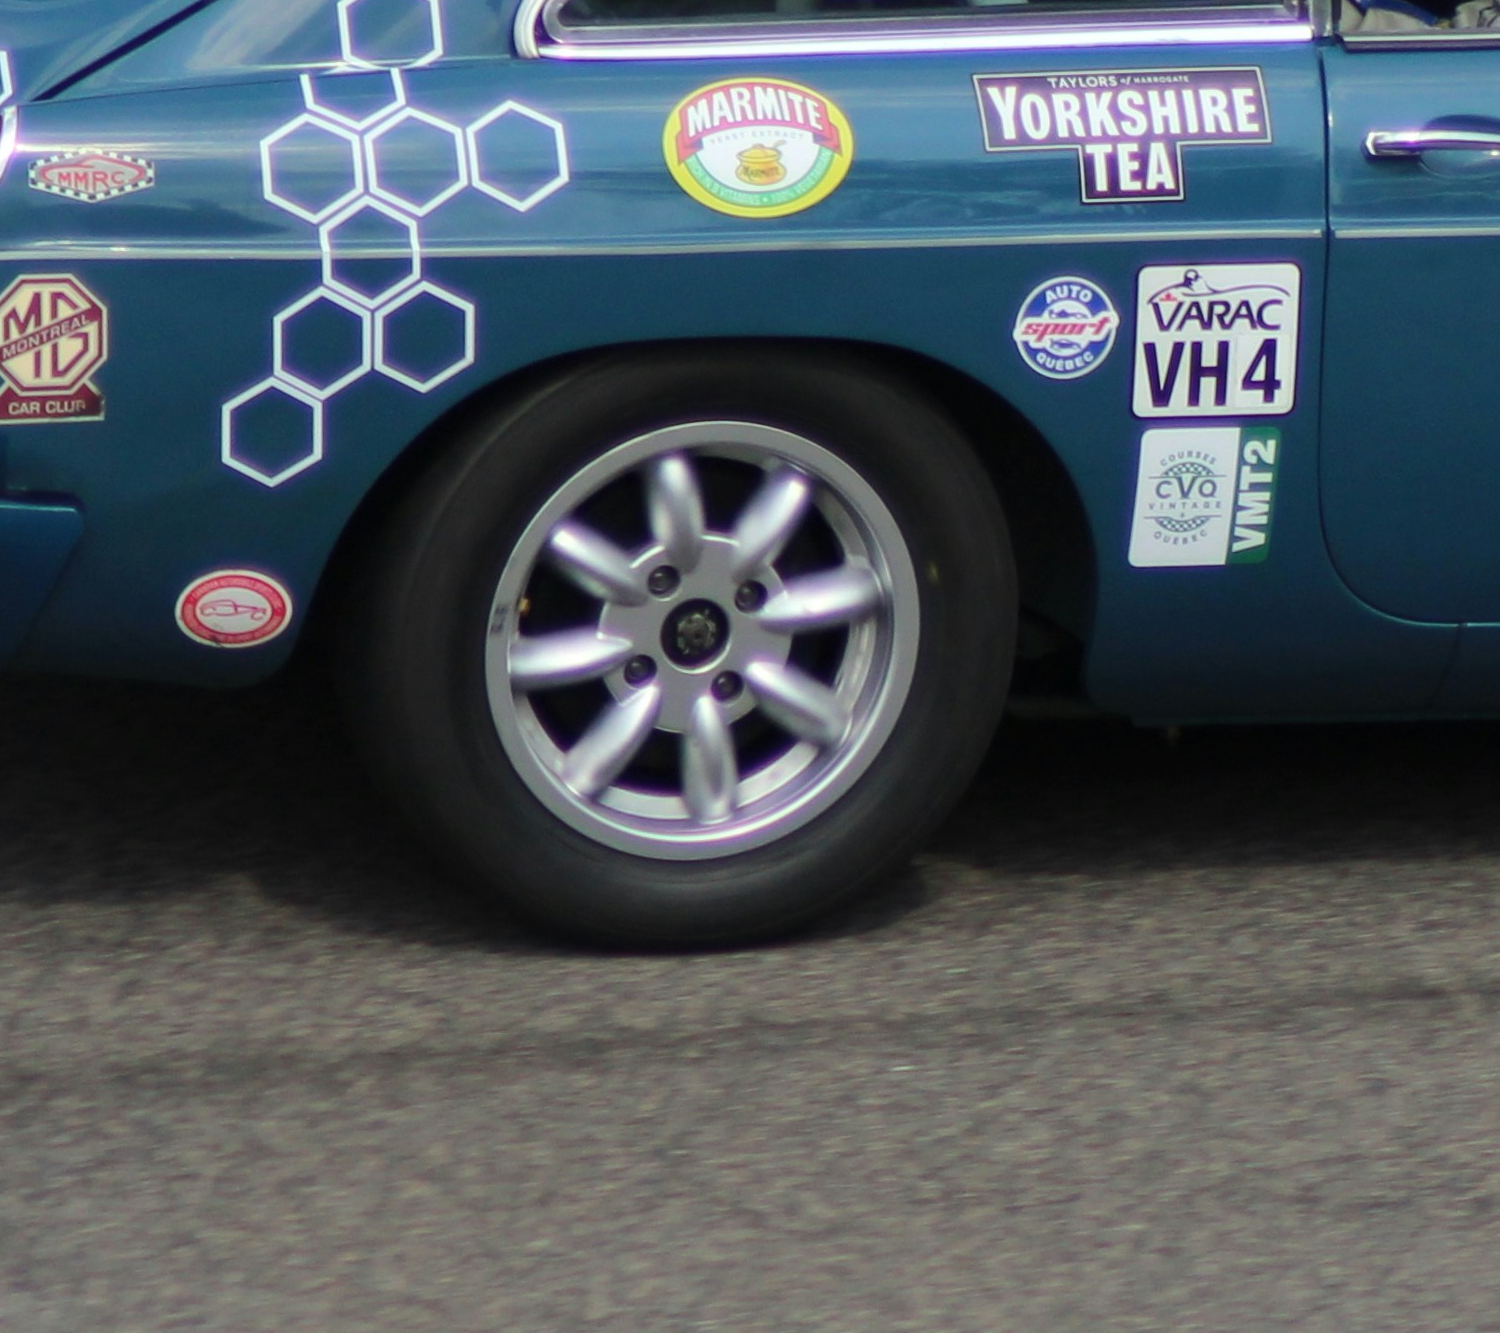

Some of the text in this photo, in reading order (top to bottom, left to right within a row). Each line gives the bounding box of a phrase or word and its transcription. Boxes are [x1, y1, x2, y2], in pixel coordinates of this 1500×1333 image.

[1046, 76, 1118, 89] TAYLORS
[687, 85, 824, 138] MARMITE
[986, 86, 1260, 140] YORKSHIRE
[1085, 141, 1176, 192] TEA
[57, 169, 125, 193] MMRC
[1045, 284, 1094, 304] AUTO
[1151, 299, 1283, 332] VARAC
[2, 314, 87, 360] MONTREAL
[1021, 316, 1111, 343] sport
[8, 401, 41, 415] CAR
[1160, 450, 1217, 467] COURSES
[1154, 475, 1218, 500] CVQ
[1231, 439, 1277, 553] VMT2
[1148, 500, 1222, 511] VINTAGE
